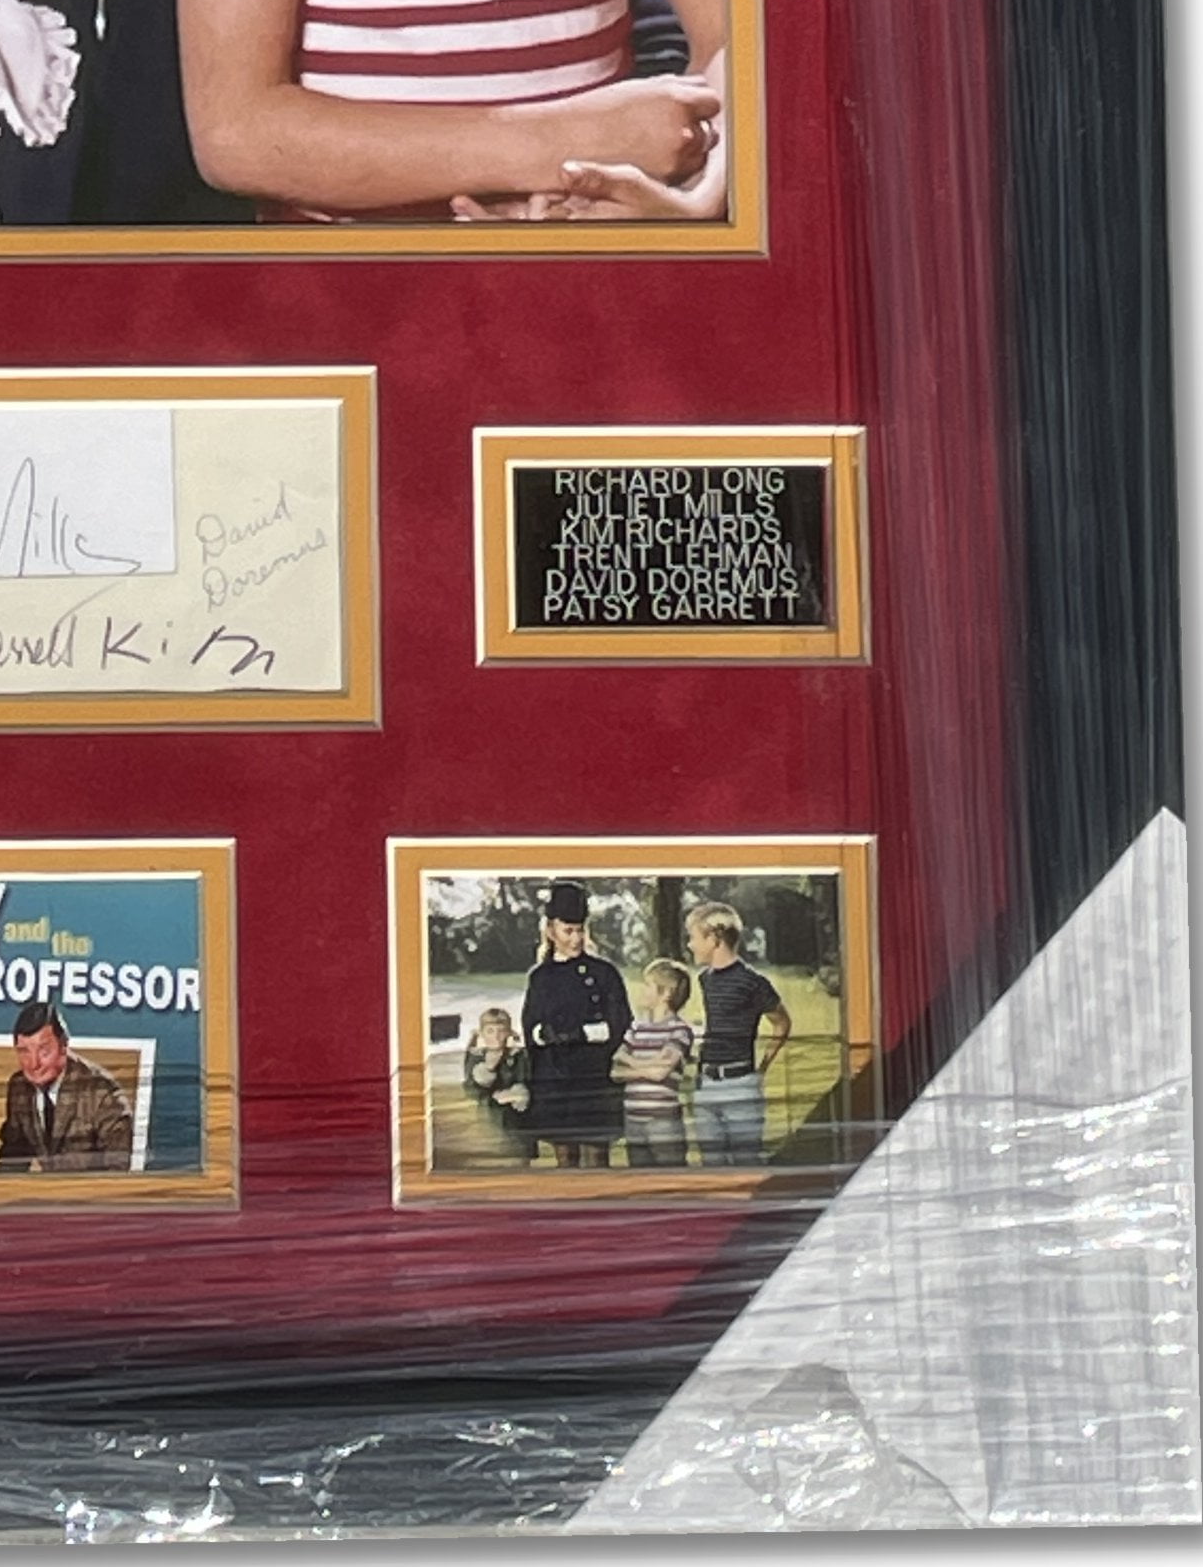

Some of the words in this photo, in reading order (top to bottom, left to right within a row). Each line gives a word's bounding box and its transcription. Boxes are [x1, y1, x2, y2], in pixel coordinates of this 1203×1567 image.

[555, 468, 691, 495] RICHARD
[703, 467, 785, 494] LONG
[565, 494, 669, 520] JULIET
[684, 492, 775, 519] MILLS
[560, 519, 614, 545] KIM
[627, 518, 781, 545] RICHARDS
[552, 544, 651, 570] TRENT
[665, 543, 792, 570] LEHMAN
[546, 569, 637, 595] DAVID
[648, 568, 797, 595] DOREMUS
[543, 595, 640, 621] PATSY
[652, 593, 799, 621] GARRETT
[3, 917, 50, 944] and
[51, 931, 92, 957] the
